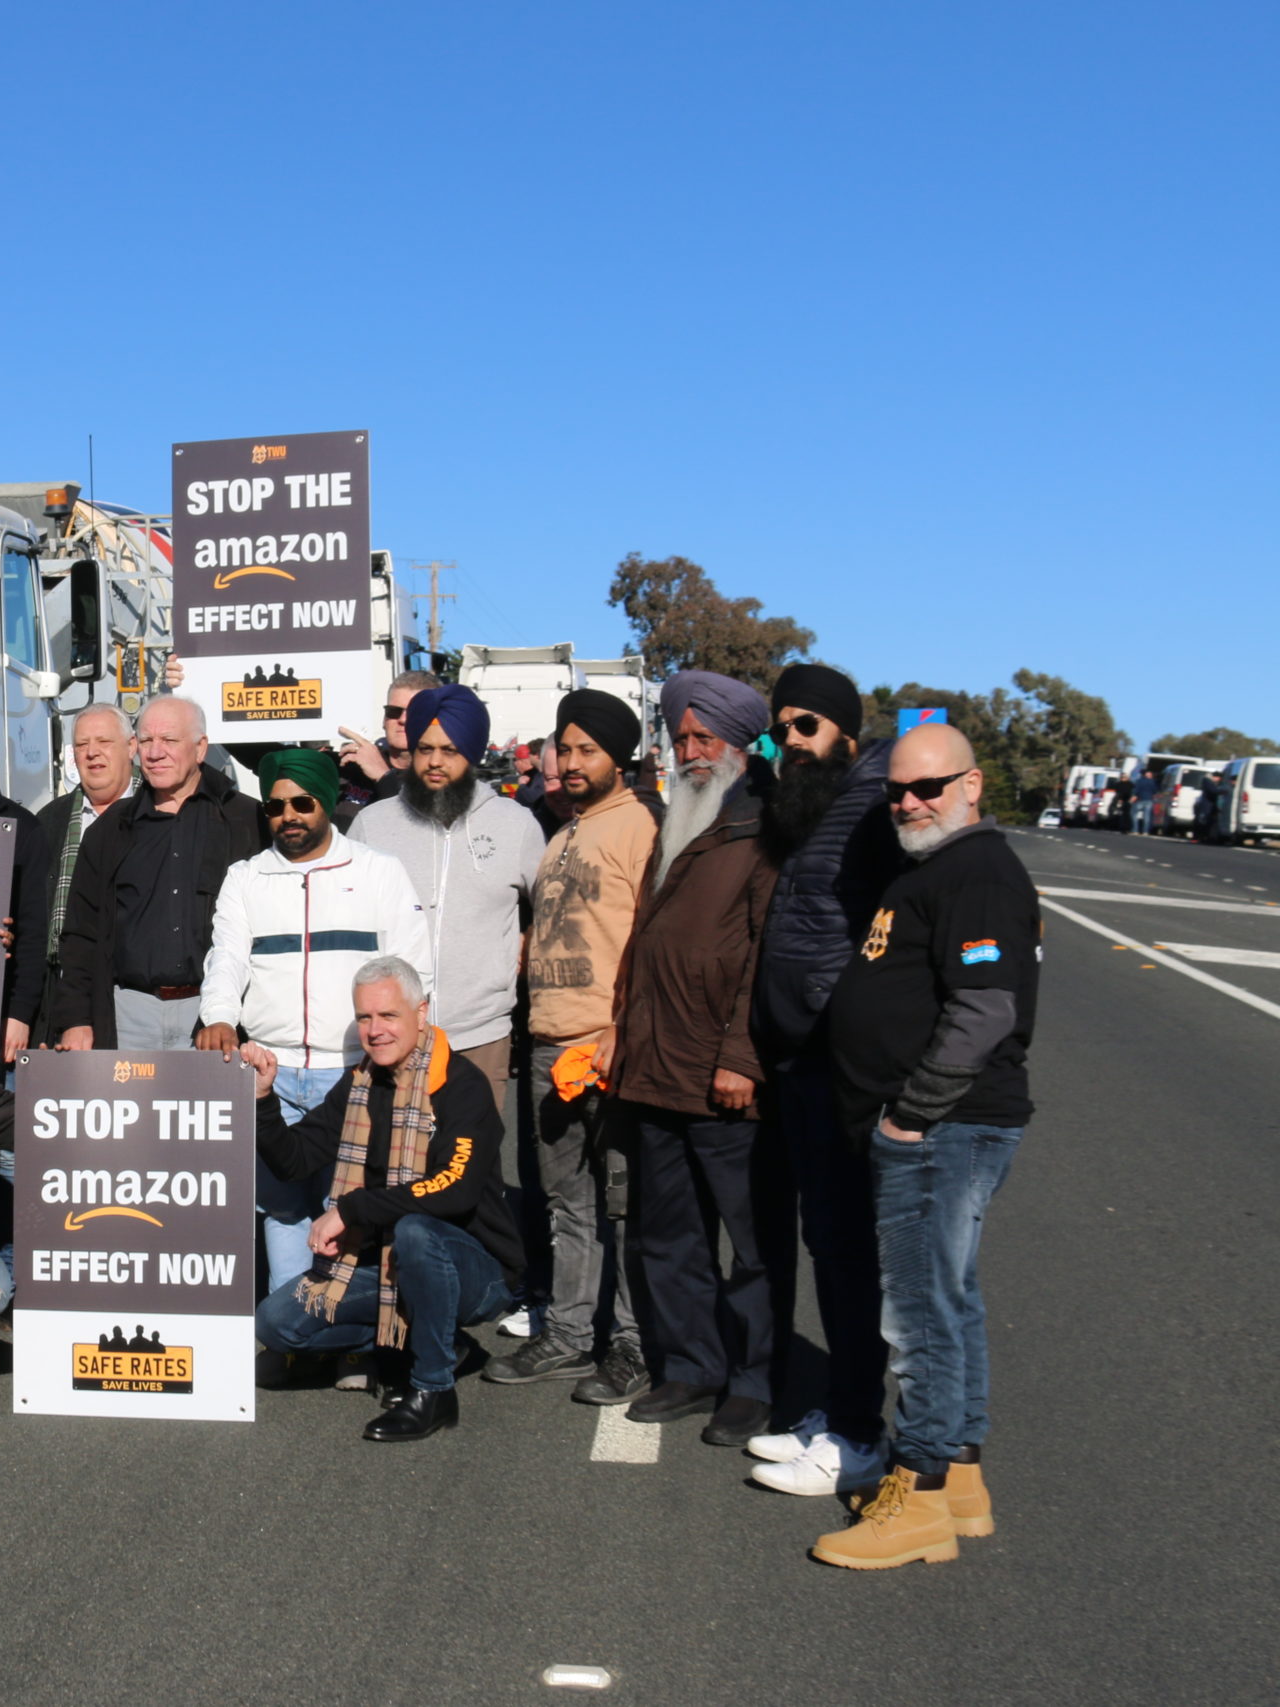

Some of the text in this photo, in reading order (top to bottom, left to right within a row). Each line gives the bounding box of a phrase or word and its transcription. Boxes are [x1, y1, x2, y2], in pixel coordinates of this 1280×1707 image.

[266, 446, 287, 457] TWU
[186, 472, 352, 515] STOP THE
[194, 530, 348, 568] amazon
[188, 599, 357, 633] EFFECT NOW
[227, 689, 317, 708] SAFE RATES
[246, 710, 297, 720] SAVE LIVES
[132, 1063, 156, 1078] TWU
[33, 1098, 233, 1141] STOP THE
[411, 1137, 472, 1198] WORKERS
[41, 1168, 227, 1206] amazon
[32, 1250, 236, 1286] EFFECT NOW
[78, 1355, 187, 1377] SAFE RATES
[102, 1380, 163, 1392] SAVE LIVES
